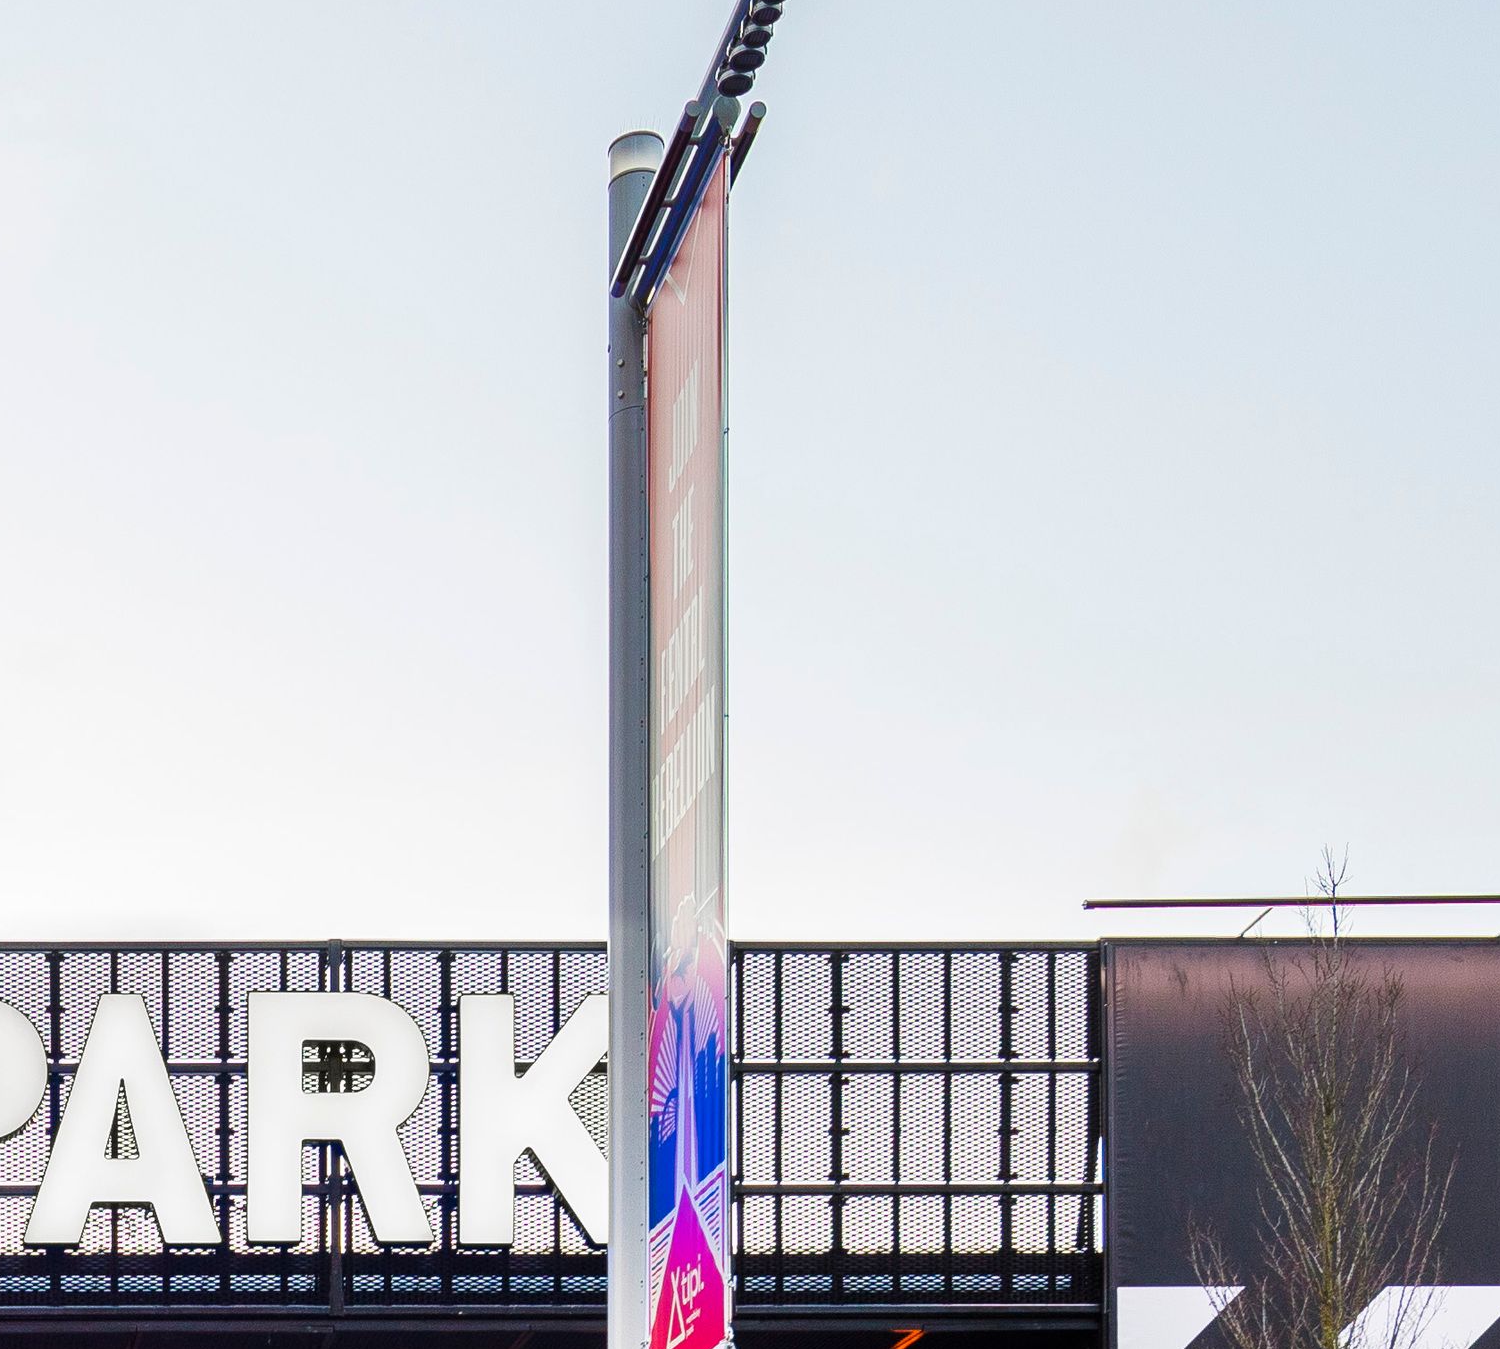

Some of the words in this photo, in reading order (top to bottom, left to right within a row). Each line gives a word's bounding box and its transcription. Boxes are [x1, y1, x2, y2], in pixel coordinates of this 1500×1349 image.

[669, 359, 698, 493] JOIN
[672, 484, 694, 600] THE
[661, 586, 705, 735] RENTAL
[652, 684, 716, 861] REBELLION
